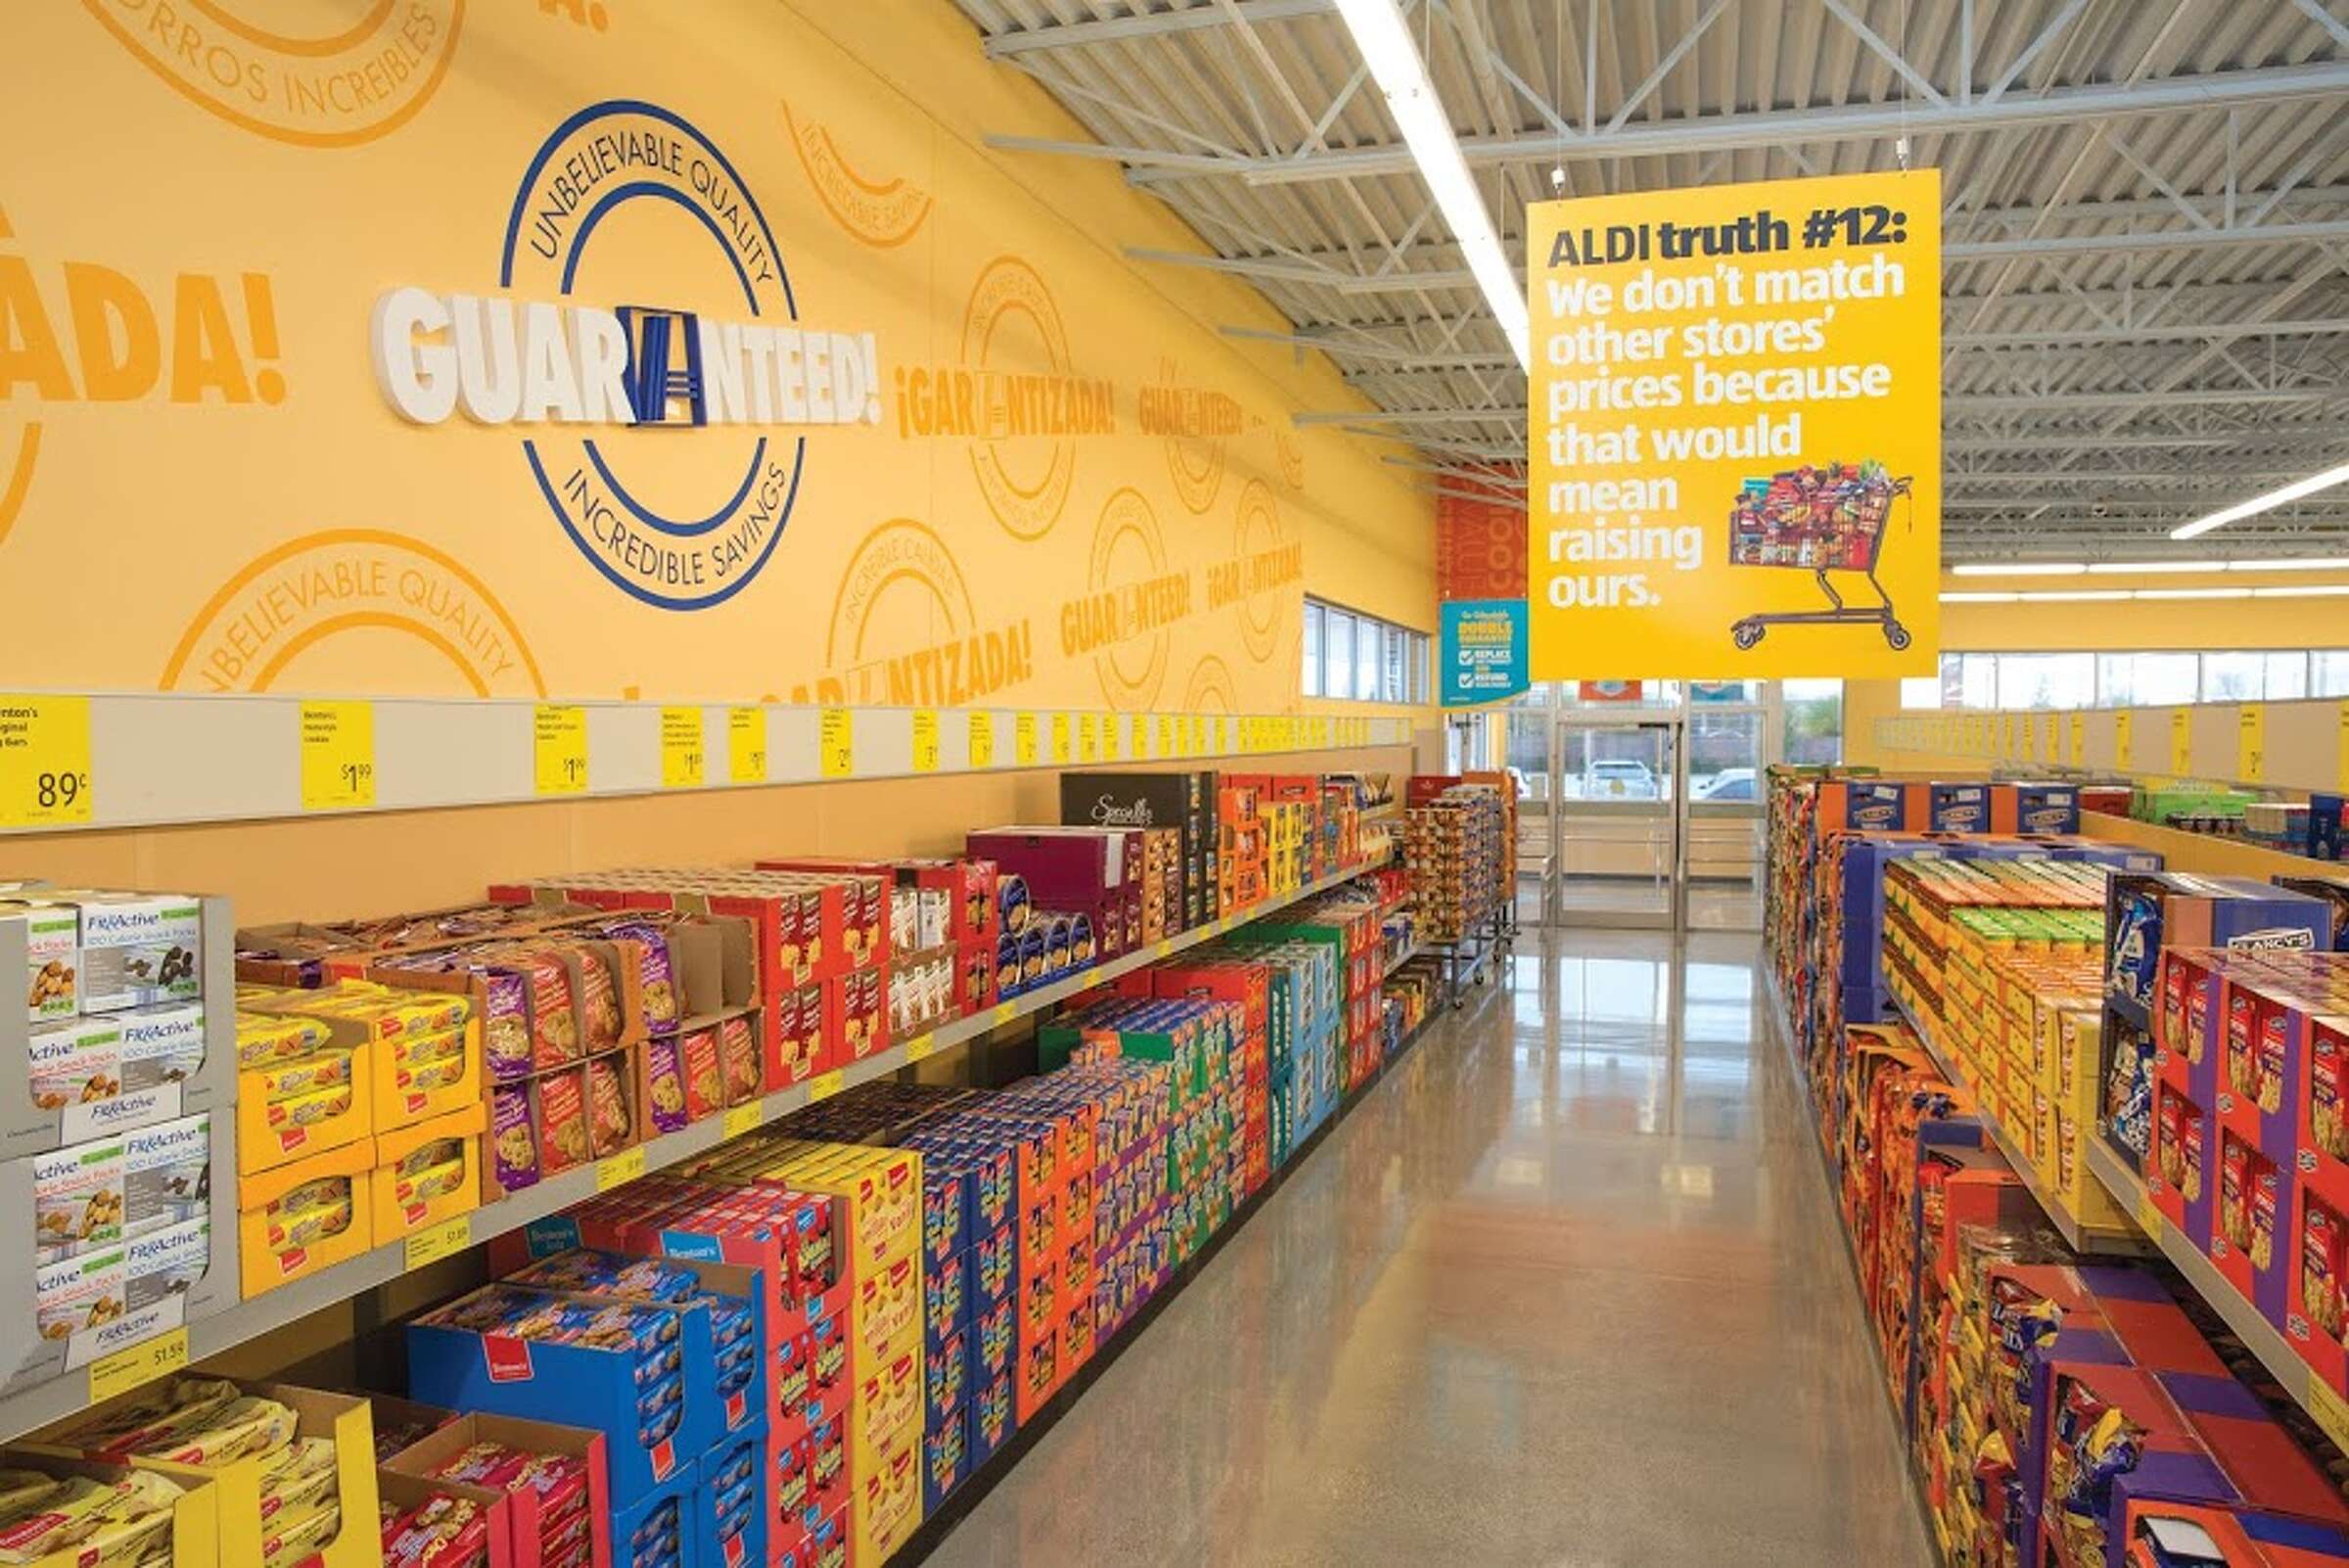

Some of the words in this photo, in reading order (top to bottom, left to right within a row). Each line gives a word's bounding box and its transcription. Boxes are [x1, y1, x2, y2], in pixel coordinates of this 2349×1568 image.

[117, 0, 268, 103] RROS
[284, 8, 438, 115] INCREIBLES
[530, 130, 683, 259] UNBELIEVABLE
[689, 160, 773, 283] QUALITY
[1547, 223, 1649, 268] ALDI
[1658, 209, 1789, 259] truth
[1803, 204, 1908, 249] #12:
[1547, 277, 1613, 318] We
[1624, 262, 1744, 313] don't
[1754, 254, 1906, 304] match
[1547, 322, 1680, 366] other
[1683, 305, 1836, 356] stores'
[1547, 366, 1681, 423] prices
[1694, 362, 1893, 405] because
[1547, 423, 1640, 466] that
[1652, 413, 1802, 462] would
[563, 468, 706, 585] INCREDIBLE
[712, 461, 786, 577] SAVINGS
[1548, 477, 1677, 514] mean
[1548, 516, 1703, 571] raising
[1548, 574, 1661, 609] ours.
[399, 570, 514, 677] QUALITY
[0, 708, 38, 718] nton's
